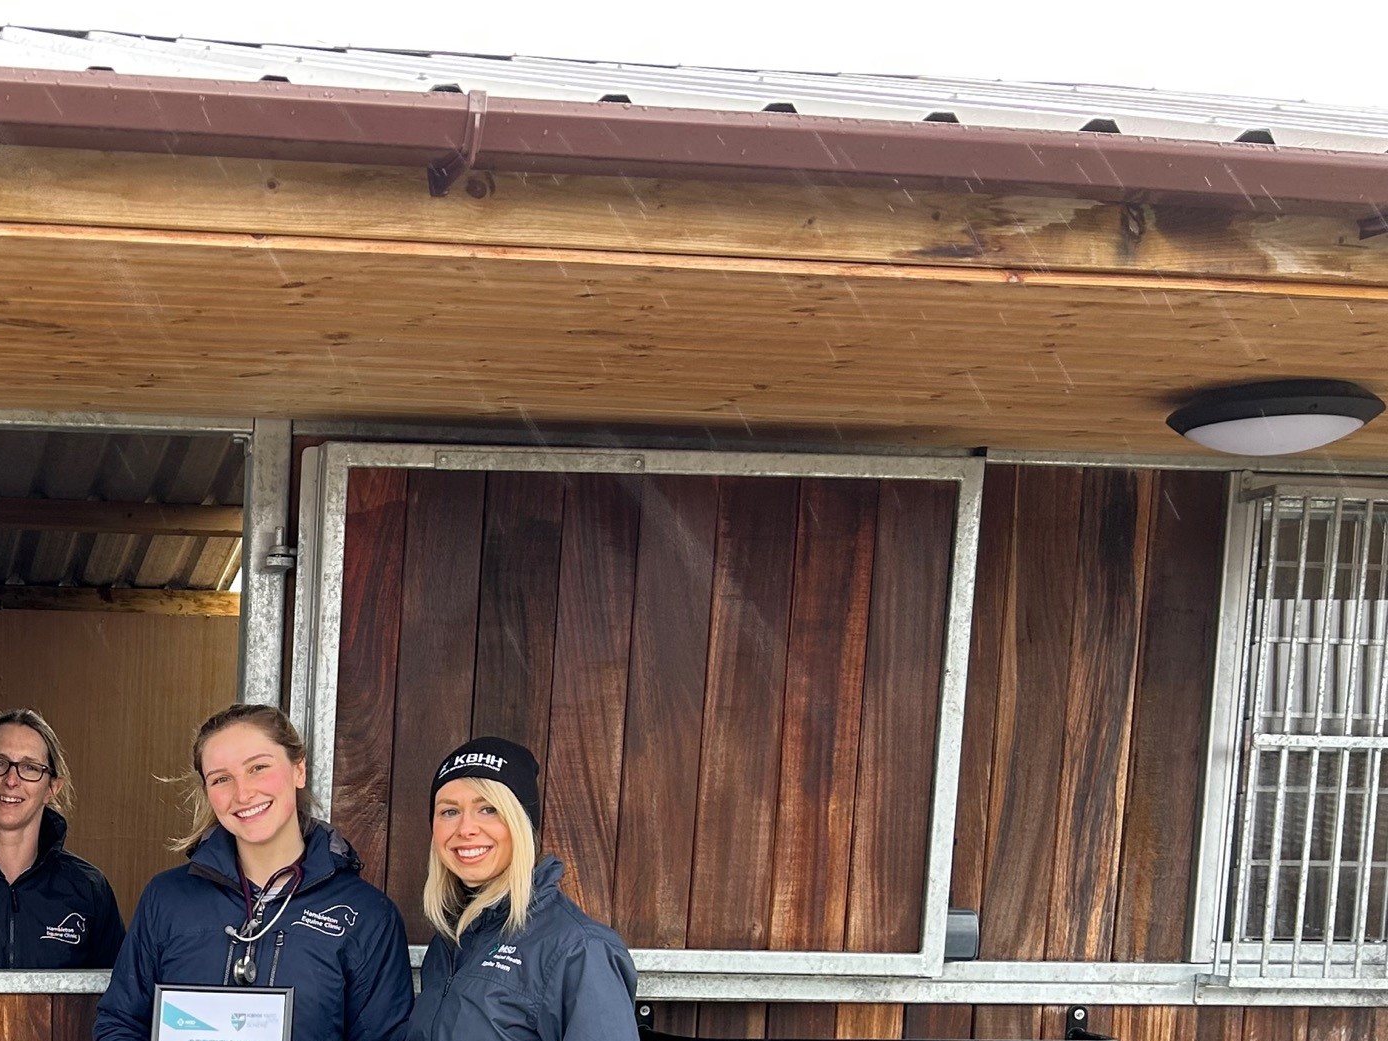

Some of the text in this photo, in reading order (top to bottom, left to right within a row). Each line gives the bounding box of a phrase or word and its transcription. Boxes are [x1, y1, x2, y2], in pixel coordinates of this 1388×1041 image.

[454, 753, 503, 768] KBHH
[301, 915, 342, 931] Equine Clinic
[303, 909, 339, 924] Hambleton
